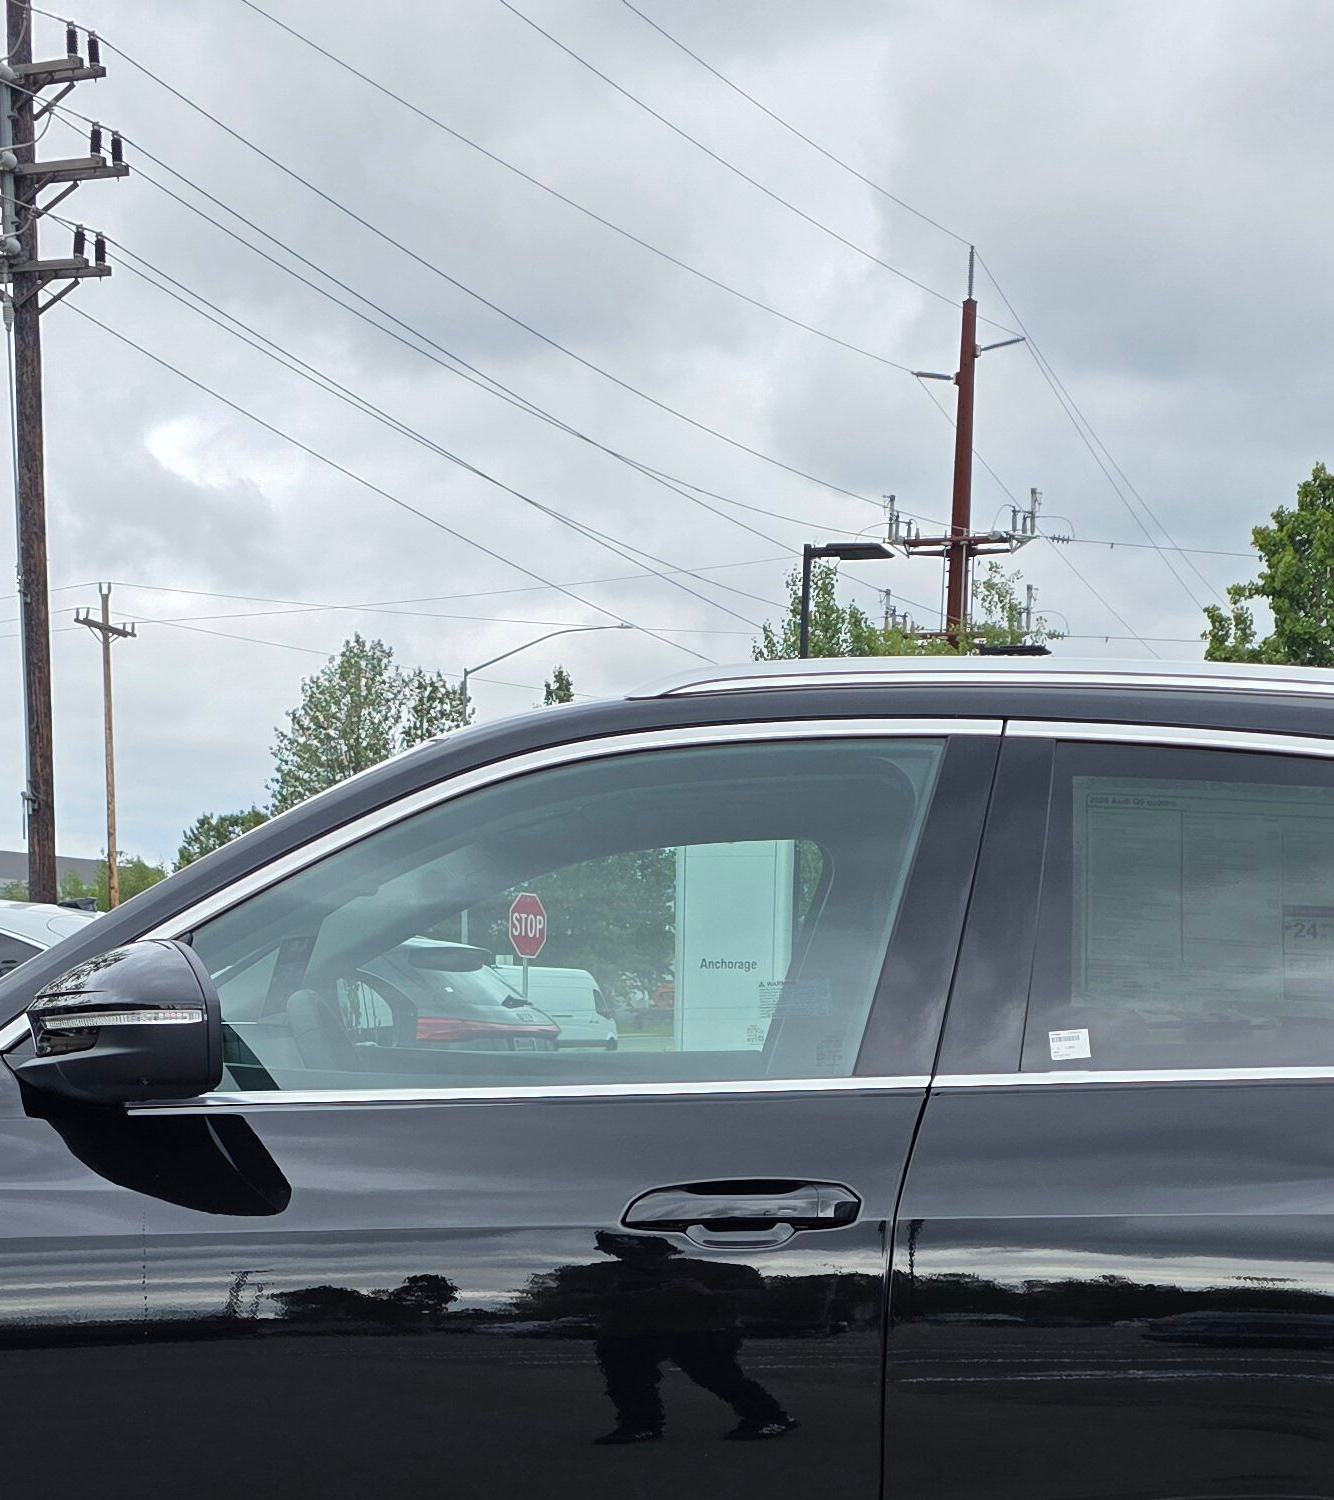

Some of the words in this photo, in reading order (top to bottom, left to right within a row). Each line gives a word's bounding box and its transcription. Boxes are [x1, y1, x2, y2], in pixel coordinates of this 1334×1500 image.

[512, 912, 544, 938] STOP
[1293, 922, 1319, 939] 24
[700, 957, 758, 973] Anchorage
